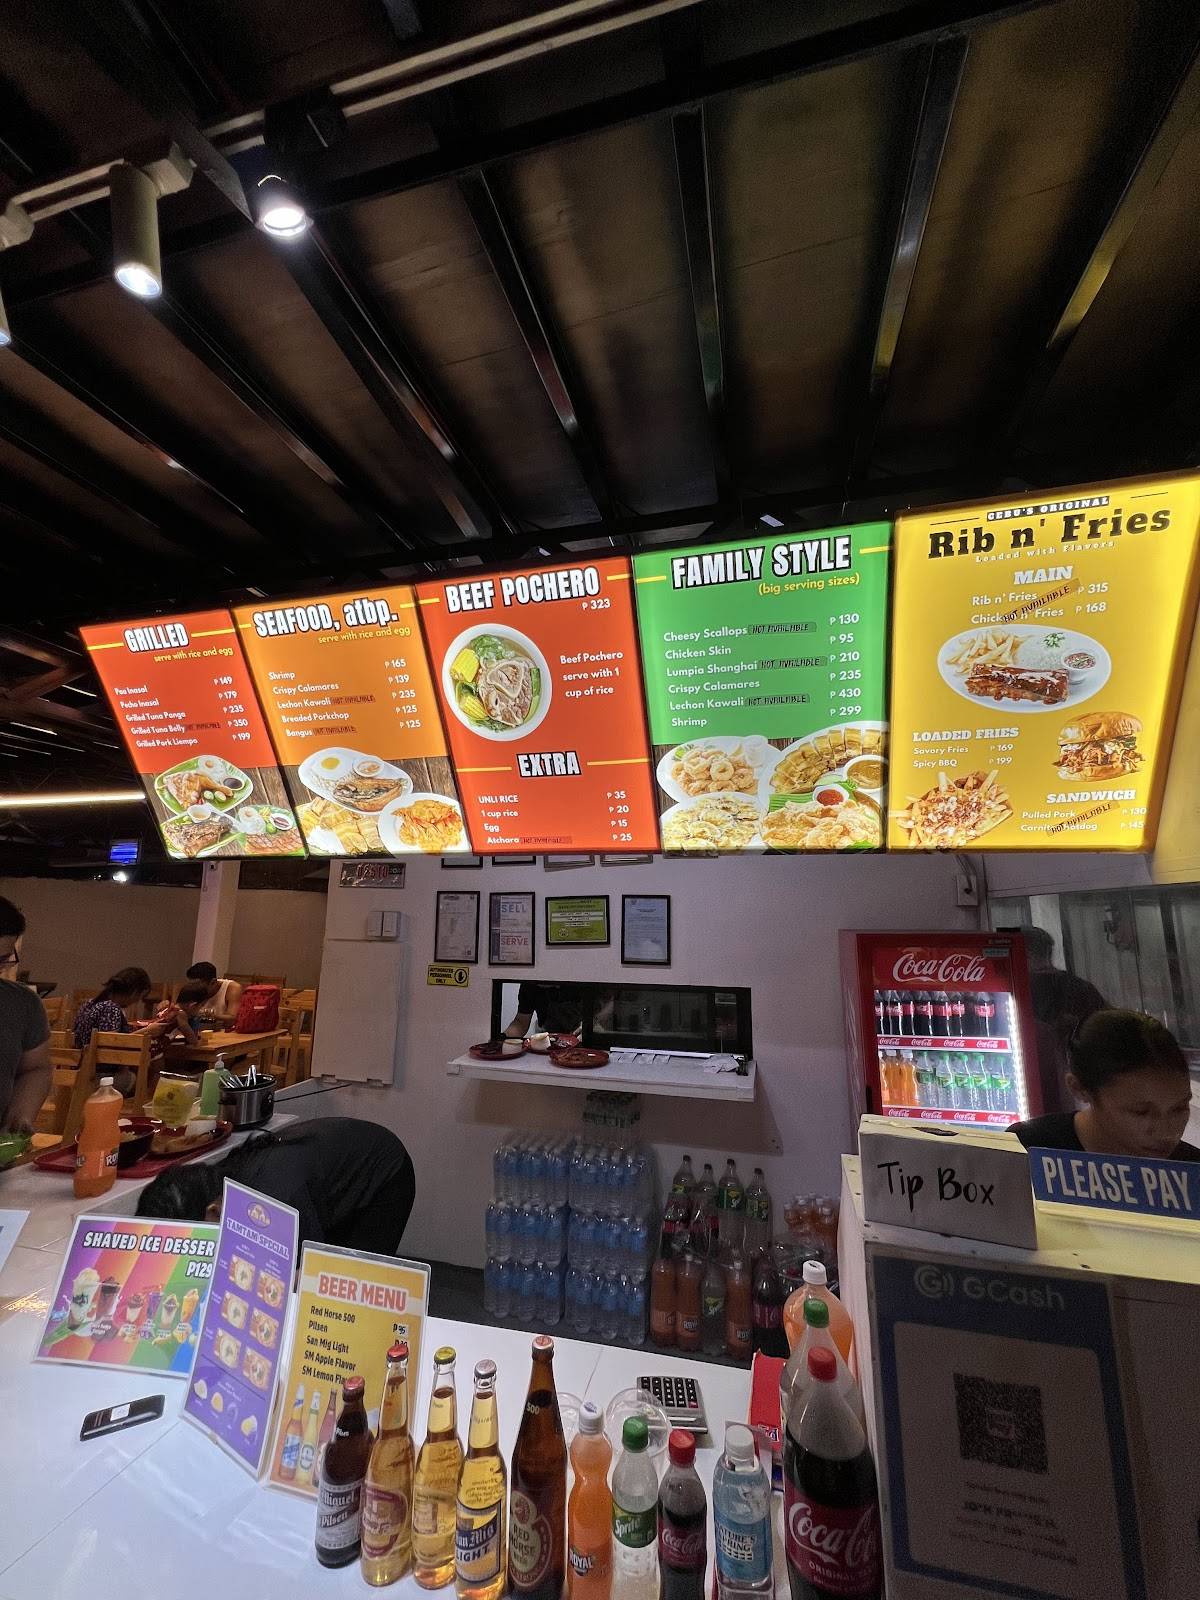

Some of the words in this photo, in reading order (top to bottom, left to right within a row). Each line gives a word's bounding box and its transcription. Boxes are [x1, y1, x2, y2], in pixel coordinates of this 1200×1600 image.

[988, 507, 1034, 520] CEBU'S
[1040, 497, 1109, 513] ORIGINAL
[928, 527, 995, 559] Rib
[1011, 518, 1045, 548] n'
[1061, 509, 1170, 542] Fries
[976, 551, 1020, 563] Loaded
[1027, 547, 1056, 557] with
[1064, 541, 1114, 552] Flavors
[671, 546, 765, 590] FAMILY
[772, 535, 851, 578] STYLE
[759, 583, 781, 595] (big
[784, 578, 824, 592] serving
[828, 572, 860, 586] sizes)
[1014, 566, 1073, 585] MAIN
[445, 580, 495, 612] BEEF
[500, 567, 600, 606] POCHERO
[972, 596, 991, 605] Rib
[995, 594, 1005, 603] n'
[1009, 592, 1037, 602] Fries
[1088, 583, 1108, 593] 315
[590, 599, 610, 609] 323
[1035, 608, 1063, 617] Fries
[1086, 603, 1106, 612] 168
[253, 603, 341, 637] SEAFOOD,
[343, 597, 398, 627] atbp.
[319, 635, 339, 643] serve
[341, 632, 357, 641] with
[376, 628, 392, 638] and
[394, 627, 410, 637] egg
[664, 632, 700, 642] Cheesy
[704, 626, 747, 638] Scallops
[839, 614, 859, 624] 130
[124, 623, 190, 653] GRILLED
[665, 650, 705, 660] Chicken
[709, 646, 731, 656] Skin
[839, 633, 853, 643] 95
[173, 651, 187, 660] with
[189, 650, 201, 658] rice
[203, 648, 216, 656] and
[218, 647, 233, 656] egg
[560, 655, 582, 664] Beef
[583, 652, 623, 661] Pochero
[268, 672, 295, 680] Shrimp
[391, 659, 406, 667] 165
[667, 667, 704, 677] Lumpia
[708, 662, 758, 674] Shanghai
[840, 651, 859, 662] 210
[272, 686, 296, 695] Crispy
[298, 683, 339, 692] Calamares
[395, 674, 409, 683] 139
[563, 673, 588, 681] serve
[591, 669, 613, 679] with
[668, 685, 700, 694] Crispy
[704, 680, 759, 691] Calamares
[840, 670, 861, 680] 235
[278, 701, 302, 709] Lechon
[304, 698, 331, 707] Kawali
[399, 690, 416, 698] 235
[566, 690, 581, 698] cup
[583, 686, 593, 695] of
[596, 686, 614, 694] rice
[670, 702, 704, 711] Lechon
[708, 698, 743, 708] Kawali
[839, 688, 861, 698] 430
[126, 713, 145, 722] Grilled
[146, 712, 163, 720] Tuna
[229, 705, 244, 713] 235
[313, 713, 349, 721] Porkchop
[402, 705, 417, 713] 125
[672, 718, 707, 727] Shrimp
[840, 706, 861, 715] 299
[131, 727, 150, 735] Grilled
[169, 724, 185, 733] Belly
[234, 719, 248, 727] 350
[286, 729, 313, 738] Bangus
[406, 720, 421, 728] 125
[913, 730, 971, 742] LOADED
[976, 728, 1019, 739] FRIES
[173, 738, 198, 746] Liempo
[238, 732, 250, 740] 199
[516, 751, 582, 777] EXTRA
[479, 796, 498, 804] UNLI
[500, 795, 518, 803] RICE
[614, 791, 626, 799] 35
[1047, 790, 1136, 803] SANDWICH
[617, 805, 629, 813] 20
[484, 823, 500, 832] Egg
[618, 819, 627, 827] 15
[620, 833, 632, 841] 25
[501, 903, 526, 912] SELL
[501, 937, 528, 945] SERVE
[877, 1160, 923, 1212] Tip
[937, 1167, 994, 1205] Box
[1042, 1156, 1138, 1204] PLEASE
[1141, 1167, 1192, 1211] PAY
[84, 1232, 137, 1250] SHAVED
[139, 1235, 160, 1252] ICE
[164, 1236, 216, 1256] DESSER
[259, 1234, 289, 1260] SPECIAL
[319, 1274, 358, 1300] BEER
[361, 1283, 407, 1311] MENU
[963, 1276, 1065, 1310] GCash
[311, 1306, 323, 1316] Red
[324, 1309, 342, 1321] Horse
[344, 1313, 355, 1323] 500
[309, 1320, 328, 1332] Pilsen
[307, 1335, 318, 1346] San
[320, 1338, 332, 1350] Mig
[333, 1340, 349, 1354] Light
[304, 1350, 314, 1360] SM
[315, 1354, 334, 1367] Apple
[335, 1358, 356, 1371] Flavor
[302, 1366, 312, 1375] SM
[313, 1369, 334, 1382] Lemon
[527, 1402, 540, 1415] 500
[514, 1524, 529, 1541] RED
